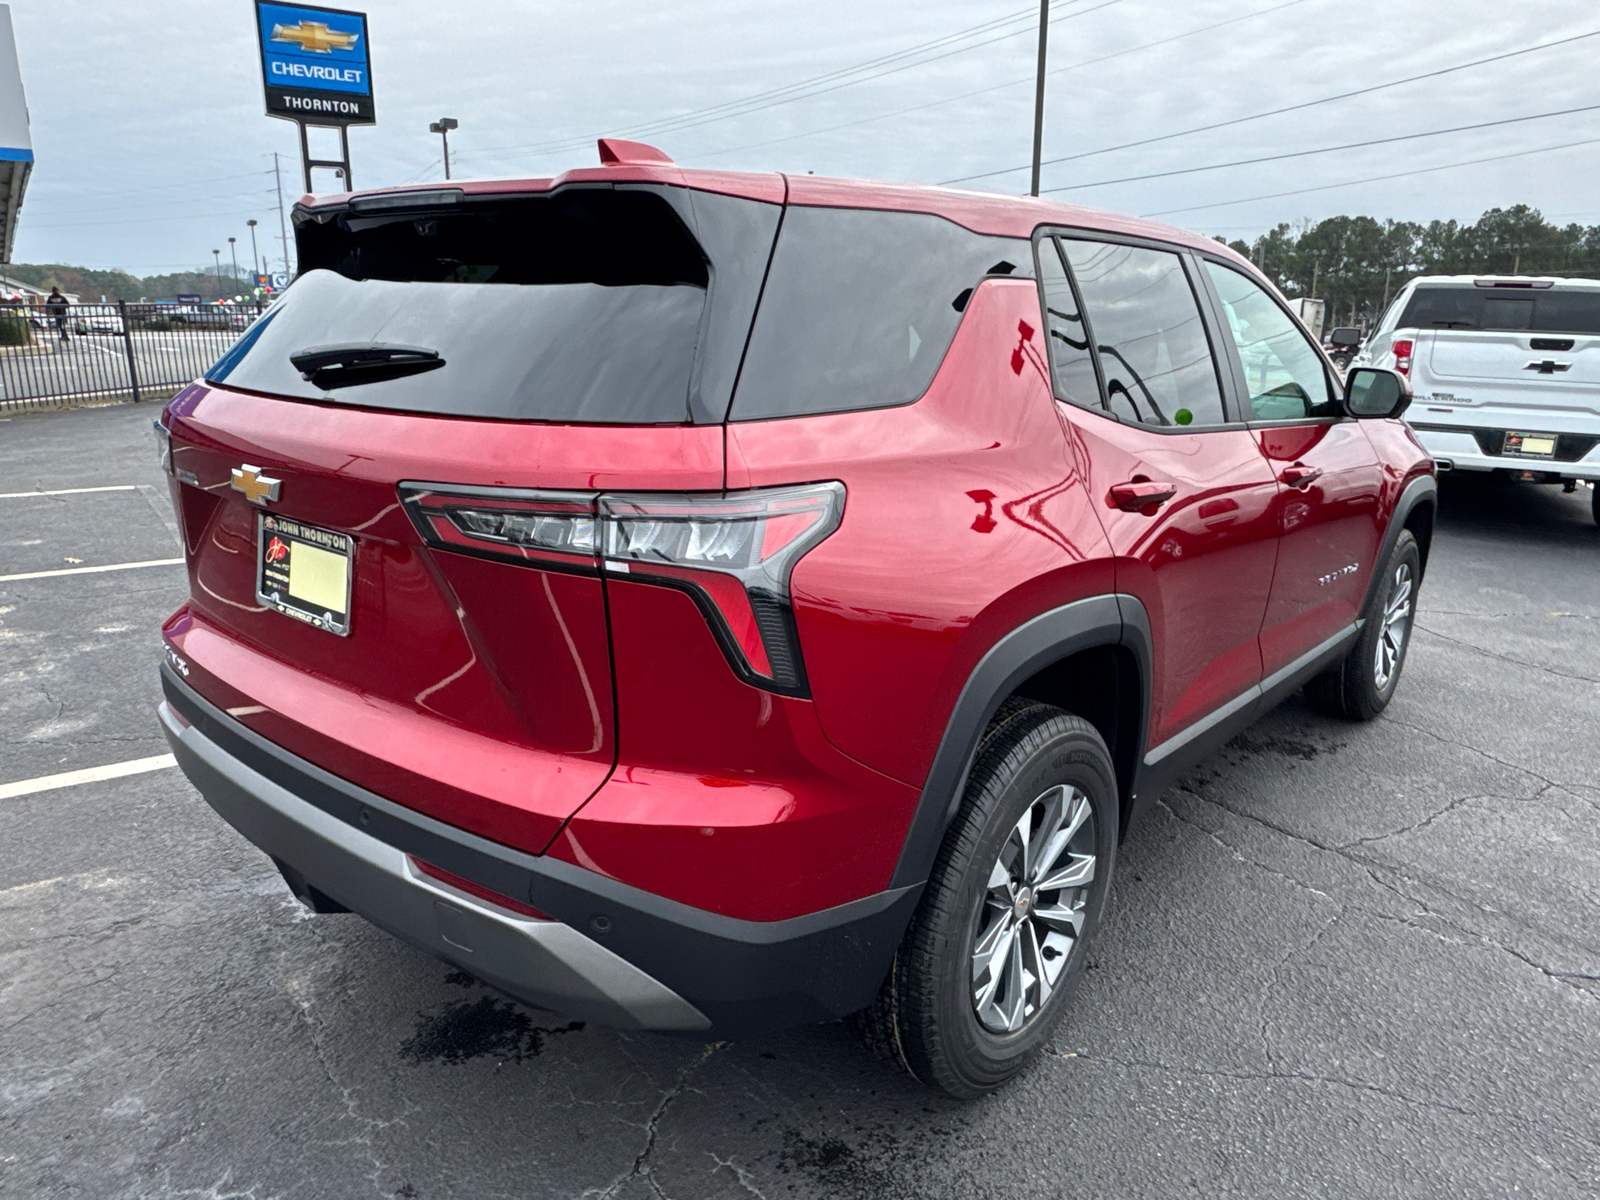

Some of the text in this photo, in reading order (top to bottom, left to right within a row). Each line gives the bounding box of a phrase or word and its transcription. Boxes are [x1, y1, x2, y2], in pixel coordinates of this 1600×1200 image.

[271, 61, 363, 83] CHEVROLET
[283, 96, 360, 114] THORNTON
[278, 521, 300, 536] JOHN
[300, 527, 347, 550] THORNTON
[285, 607, 313, 623] CHEVROLET
